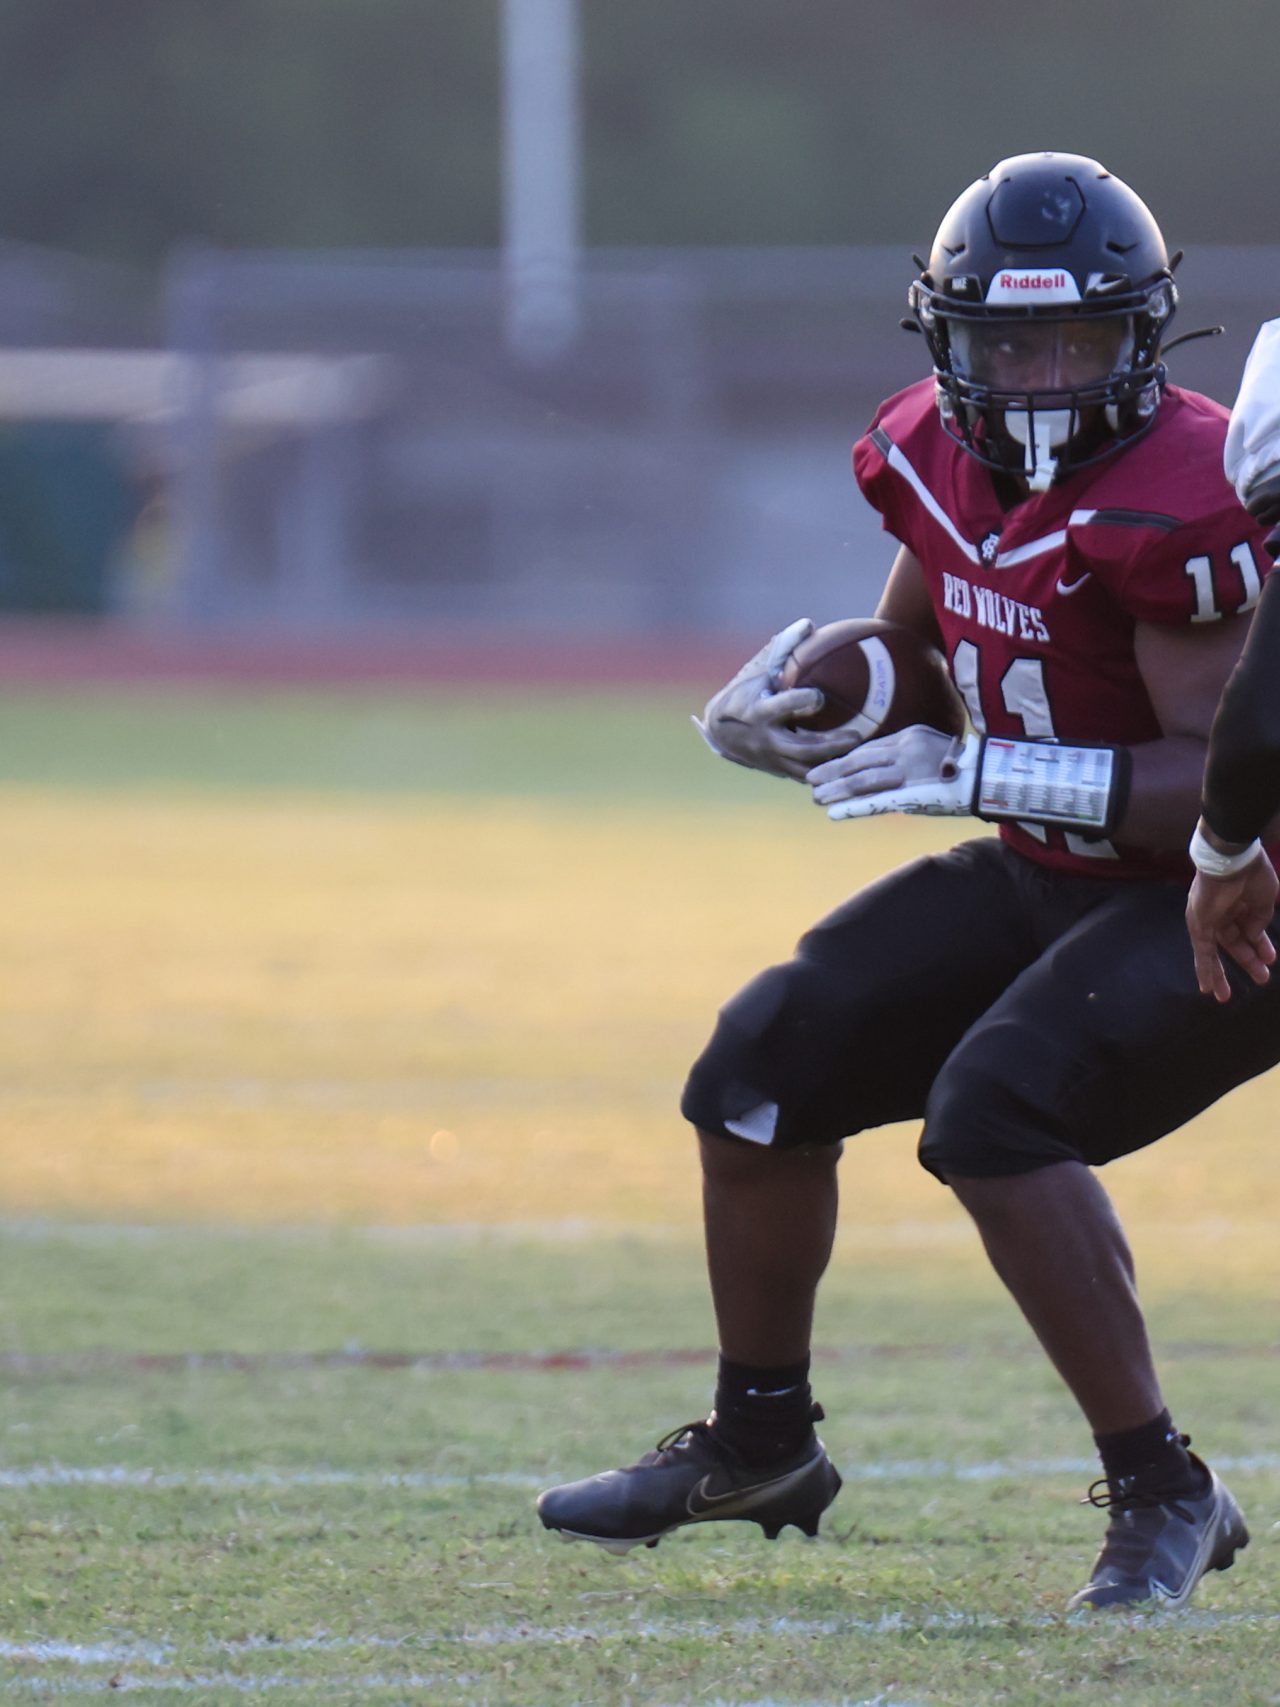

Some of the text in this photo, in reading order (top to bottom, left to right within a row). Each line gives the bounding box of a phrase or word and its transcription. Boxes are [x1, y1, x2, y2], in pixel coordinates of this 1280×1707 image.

[1000, 274, 1066, 288] Riddell
[942, 571, 1051, 642] RED WOLVES
[1185, 541, 1261, 622] 11
